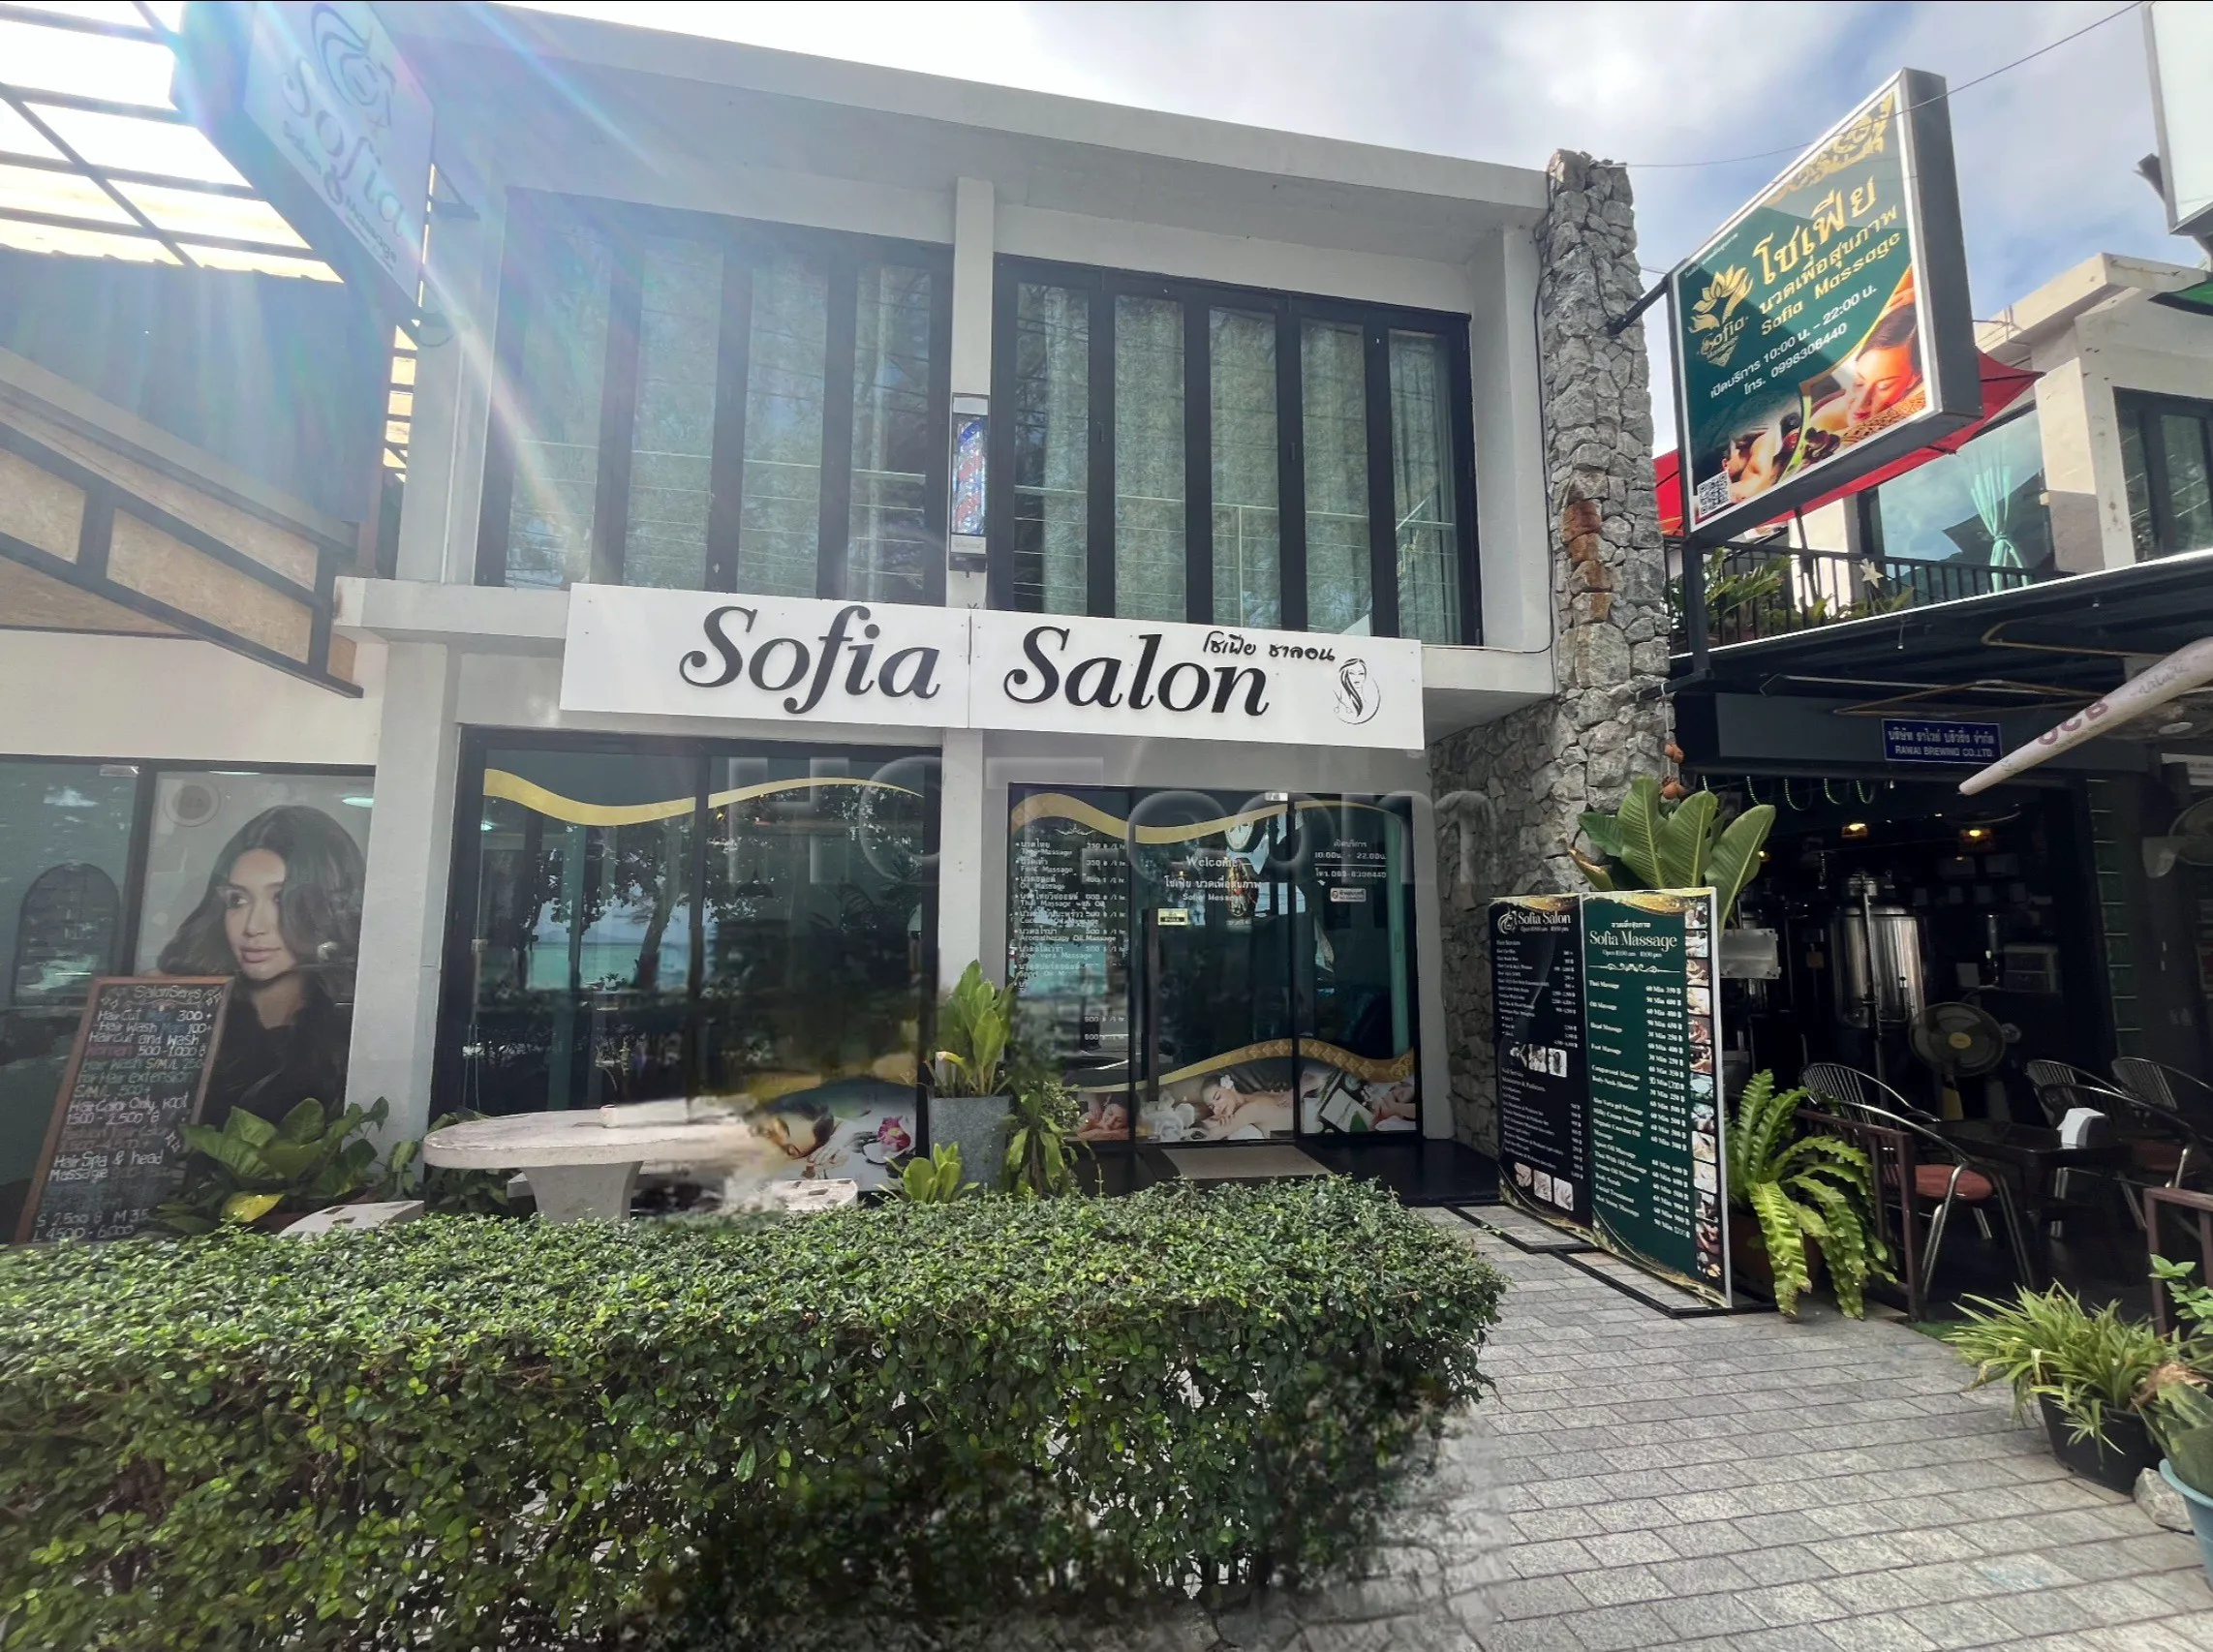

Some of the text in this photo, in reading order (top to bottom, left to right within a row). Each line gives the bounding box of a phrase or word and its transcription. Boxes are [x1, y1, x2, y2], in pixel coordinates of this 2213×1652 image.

[281, 58, 405, 238] Sofia
[1752, 175, 1877, 286] โซเฟีย
[1759, 204, 1899, 315] นวดเพื่อสุขภาพ
[1762, 232, 1901, 336] Sofia Massage
[1710, 360, 1762, 399] เปิดบริการ
[1764, 338, 1796, 364] 10:00
[1823, 293, 1860, 325] 22:00
[1770, 321, 1848, 379] 0998308440
[679, 604, 1272, 717] Sofia Salon
[1269, 643, 1336, 661] ซาลอน
[2038, 699, 2108, 745] OCB
[1894, 745, 1921, 754] RAWAI
[1923, 747, 1959, 756] BREWING
[1185, 856, 1239, 868] Welcome
[1518, 910, 1571, 925] Sofia Salon
[1086, 934, 1117, 943] Massage
[1589, 930, 1677, 953] Sofia Massage
[138, 1033, 162, 1045] and
[53, 1154, 81, 1169] Hair
[81, 1150, 108, 1170] Spa
[131, 1148, 165, 1166] head
[48, 1168, 109, 1185] Massage
